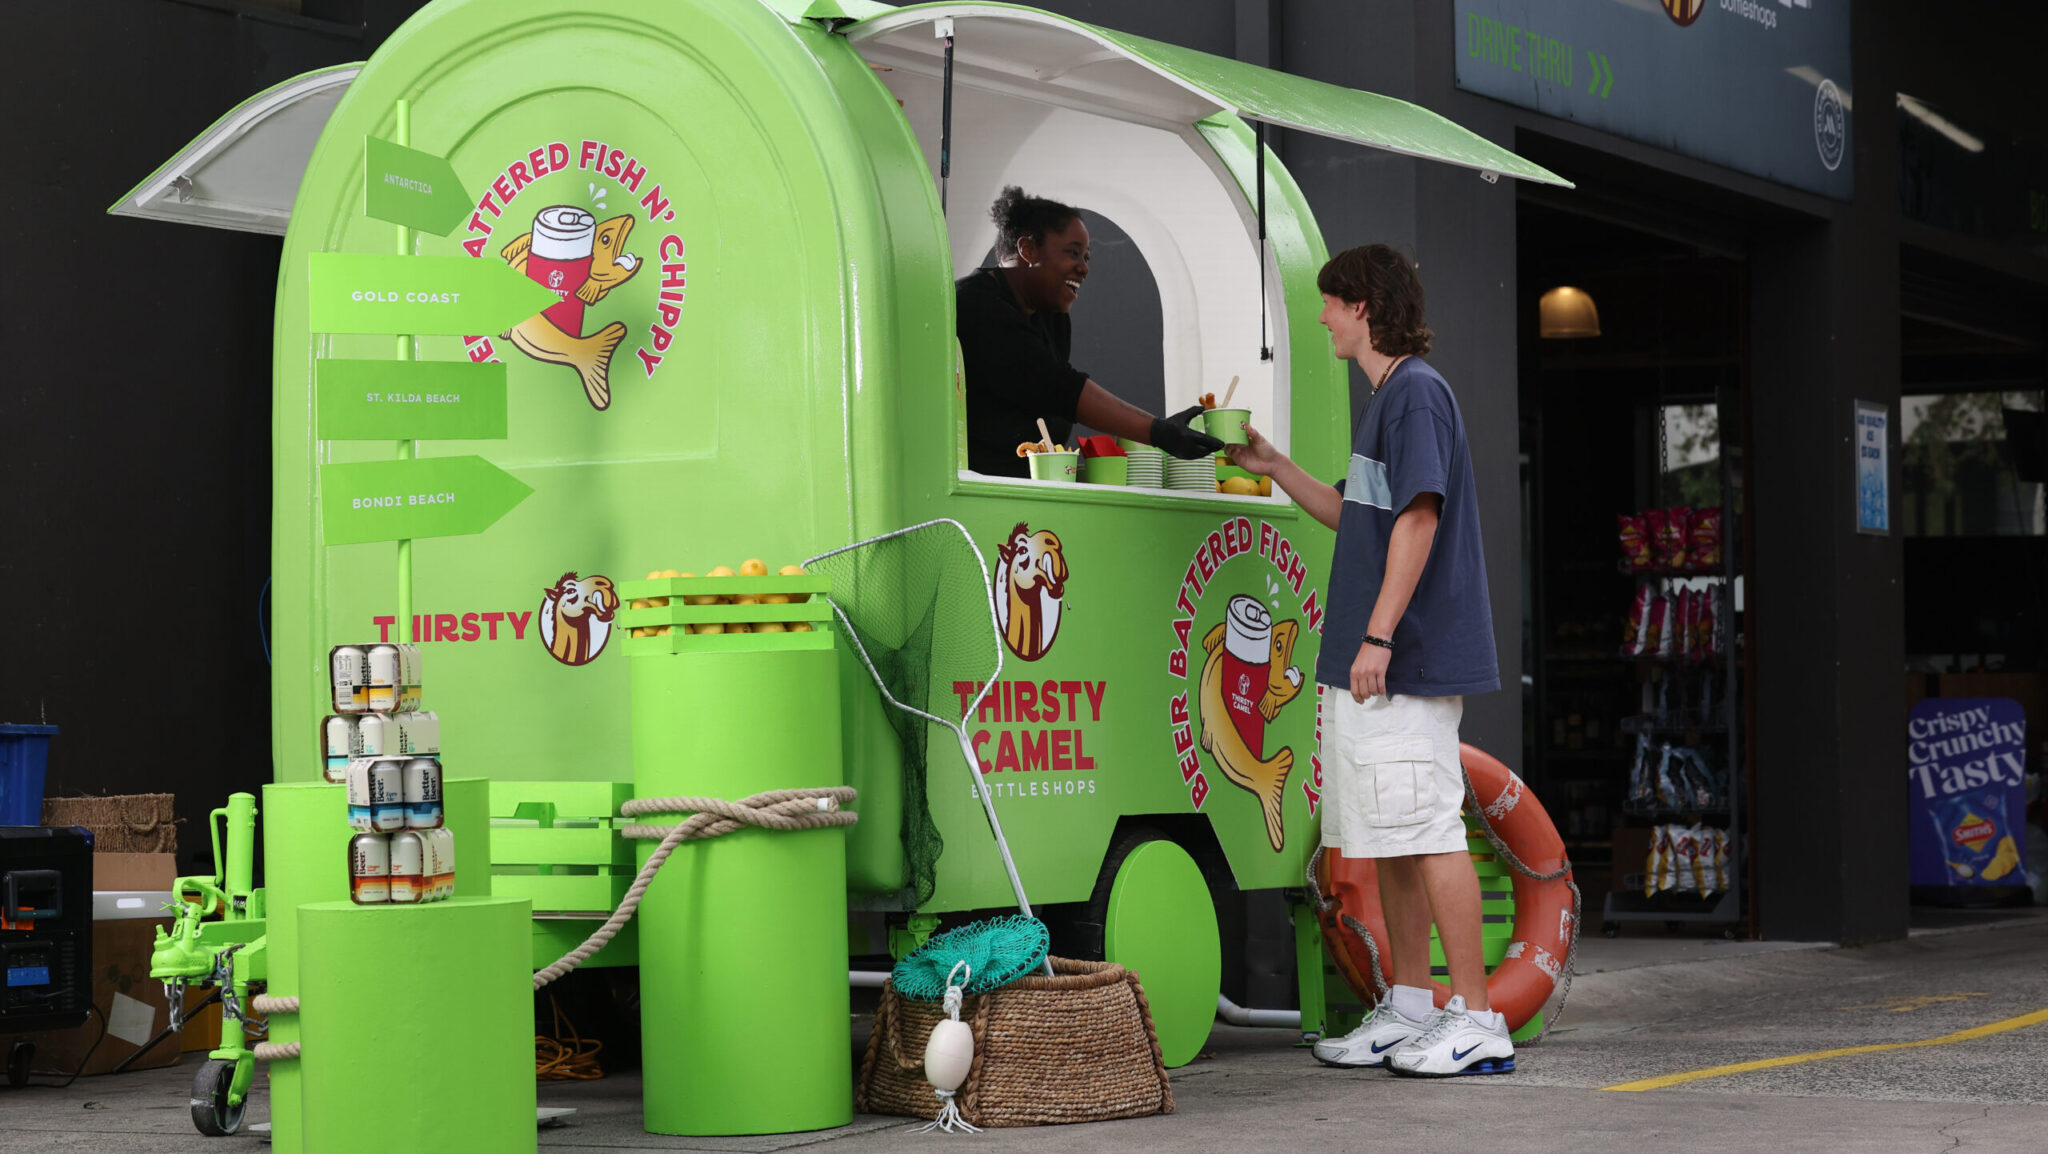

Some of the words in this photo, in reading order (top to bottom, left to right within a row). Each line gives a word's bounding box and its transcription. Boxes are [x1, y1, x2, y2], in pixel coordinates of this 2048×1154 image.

[1467, 12, 1523, 73] DRIVE
[1525, 31, 1573, 88] THRU
[384, 172, 433, 194] ANTARCTICA
[578, 139, 648, 195] FISH
[462, 141, 571, 258] ATTERED
[639, 183, 676, 223] N'
[351, 290, 400, 303] GOLD
[405, 291, 461, 304] COAST
[635, 233, 687, 379] CHIPPY
[366, 392, 384, 403] ST.
[387, 392, 422, 403] KILDA
[425, 393, 460, 403] BEACH
[352, 495, 402, 509] BONDI
[408, 492, 456, 506] BEACH
[1257, 518, 1307, 597] FISH
[1167, 516, 1253, 680] BATTERED
[953, 679, 1107, 723] THIRSTY
[1231, 692, 1254, 708] THIRSTY
[1908, 705, 1990, 740] Crispy
[971, 729, 1095, 775] CAMEL
[1168, 688, 1210, 812] BEER
[1908, 719, 2027, 765] Crunchy
[1908, 748, 2027, 799] Tasty
